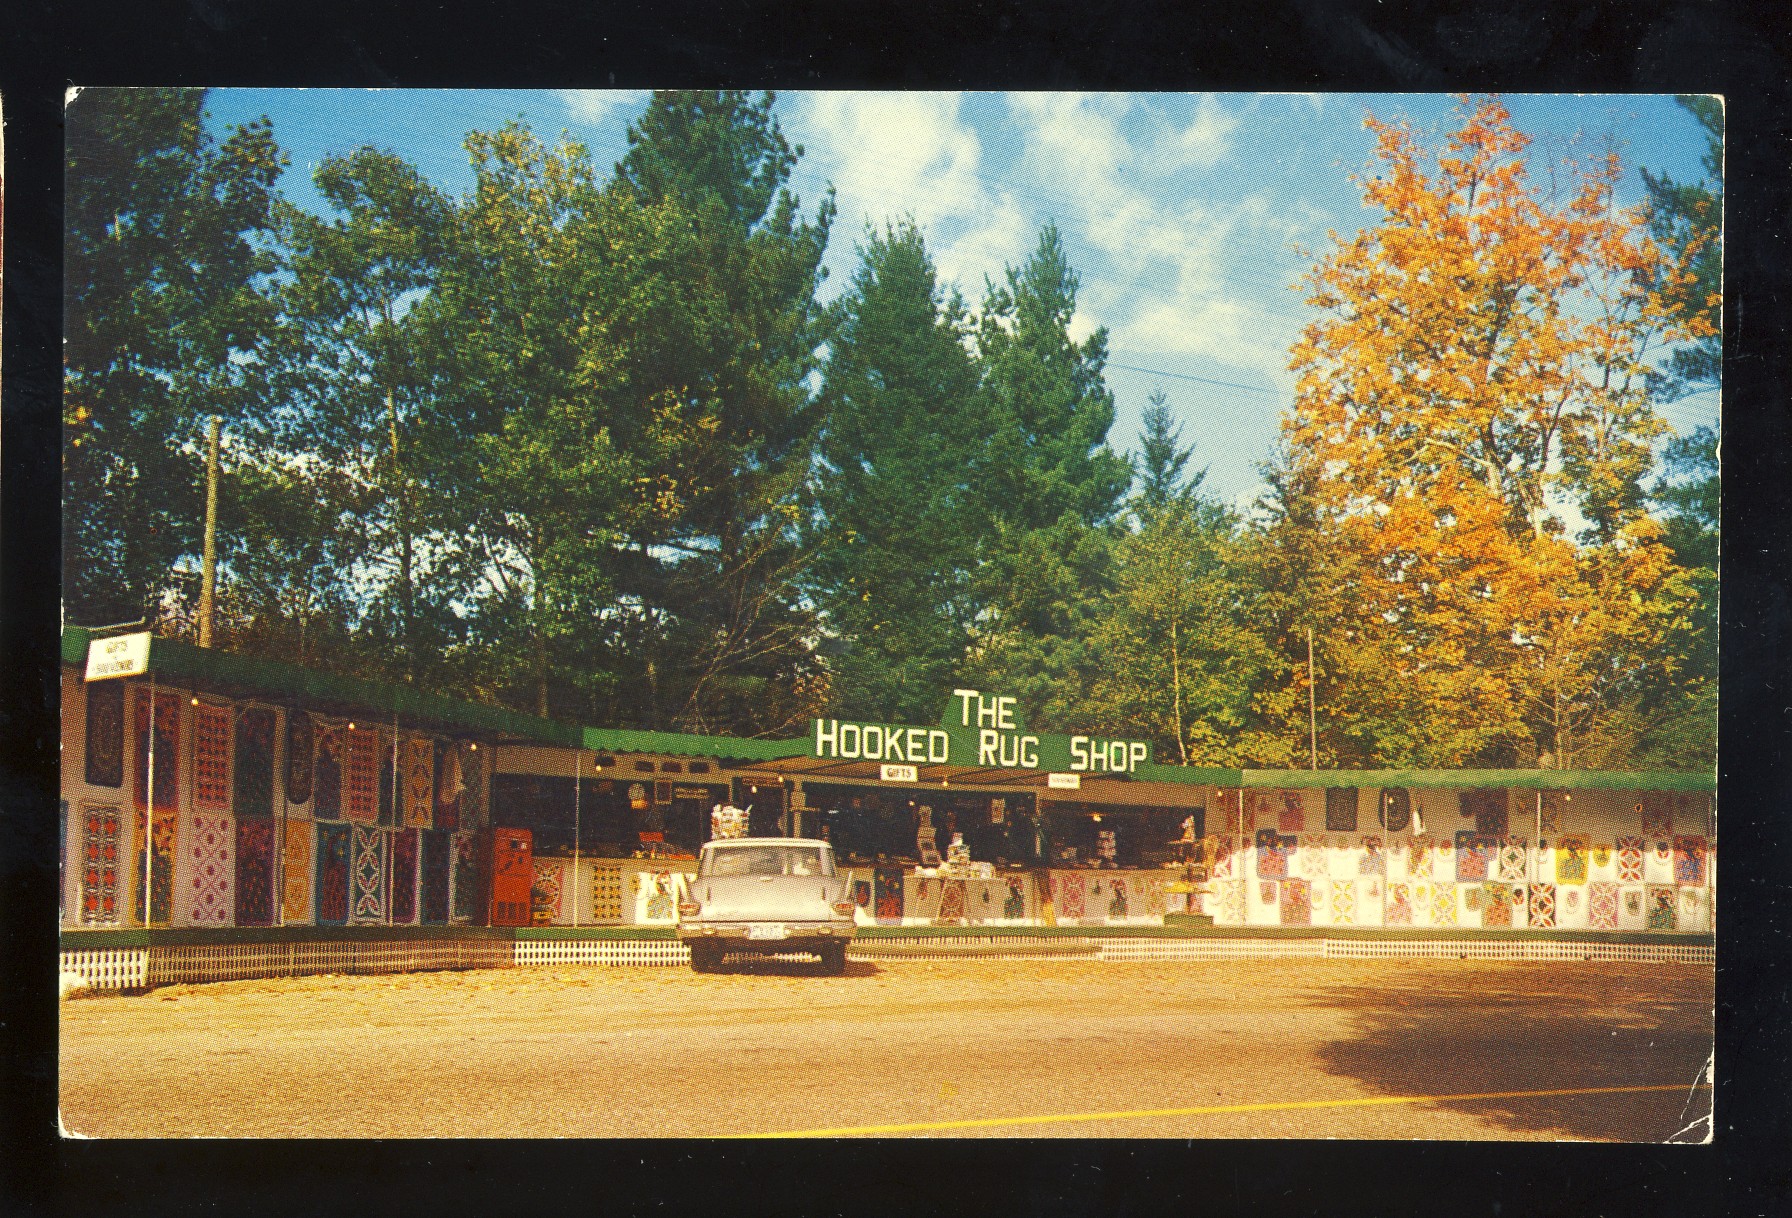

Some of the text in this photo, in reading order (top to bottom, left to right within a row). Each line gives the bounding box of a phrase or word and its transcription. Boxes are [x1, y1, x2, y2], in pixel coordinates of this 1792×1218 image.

[953, 688, 1017, 729] THE
[815, 718, 1147, 773] HOOKED RUG SHOP
[886, 767, 912, 778] GIFTS
